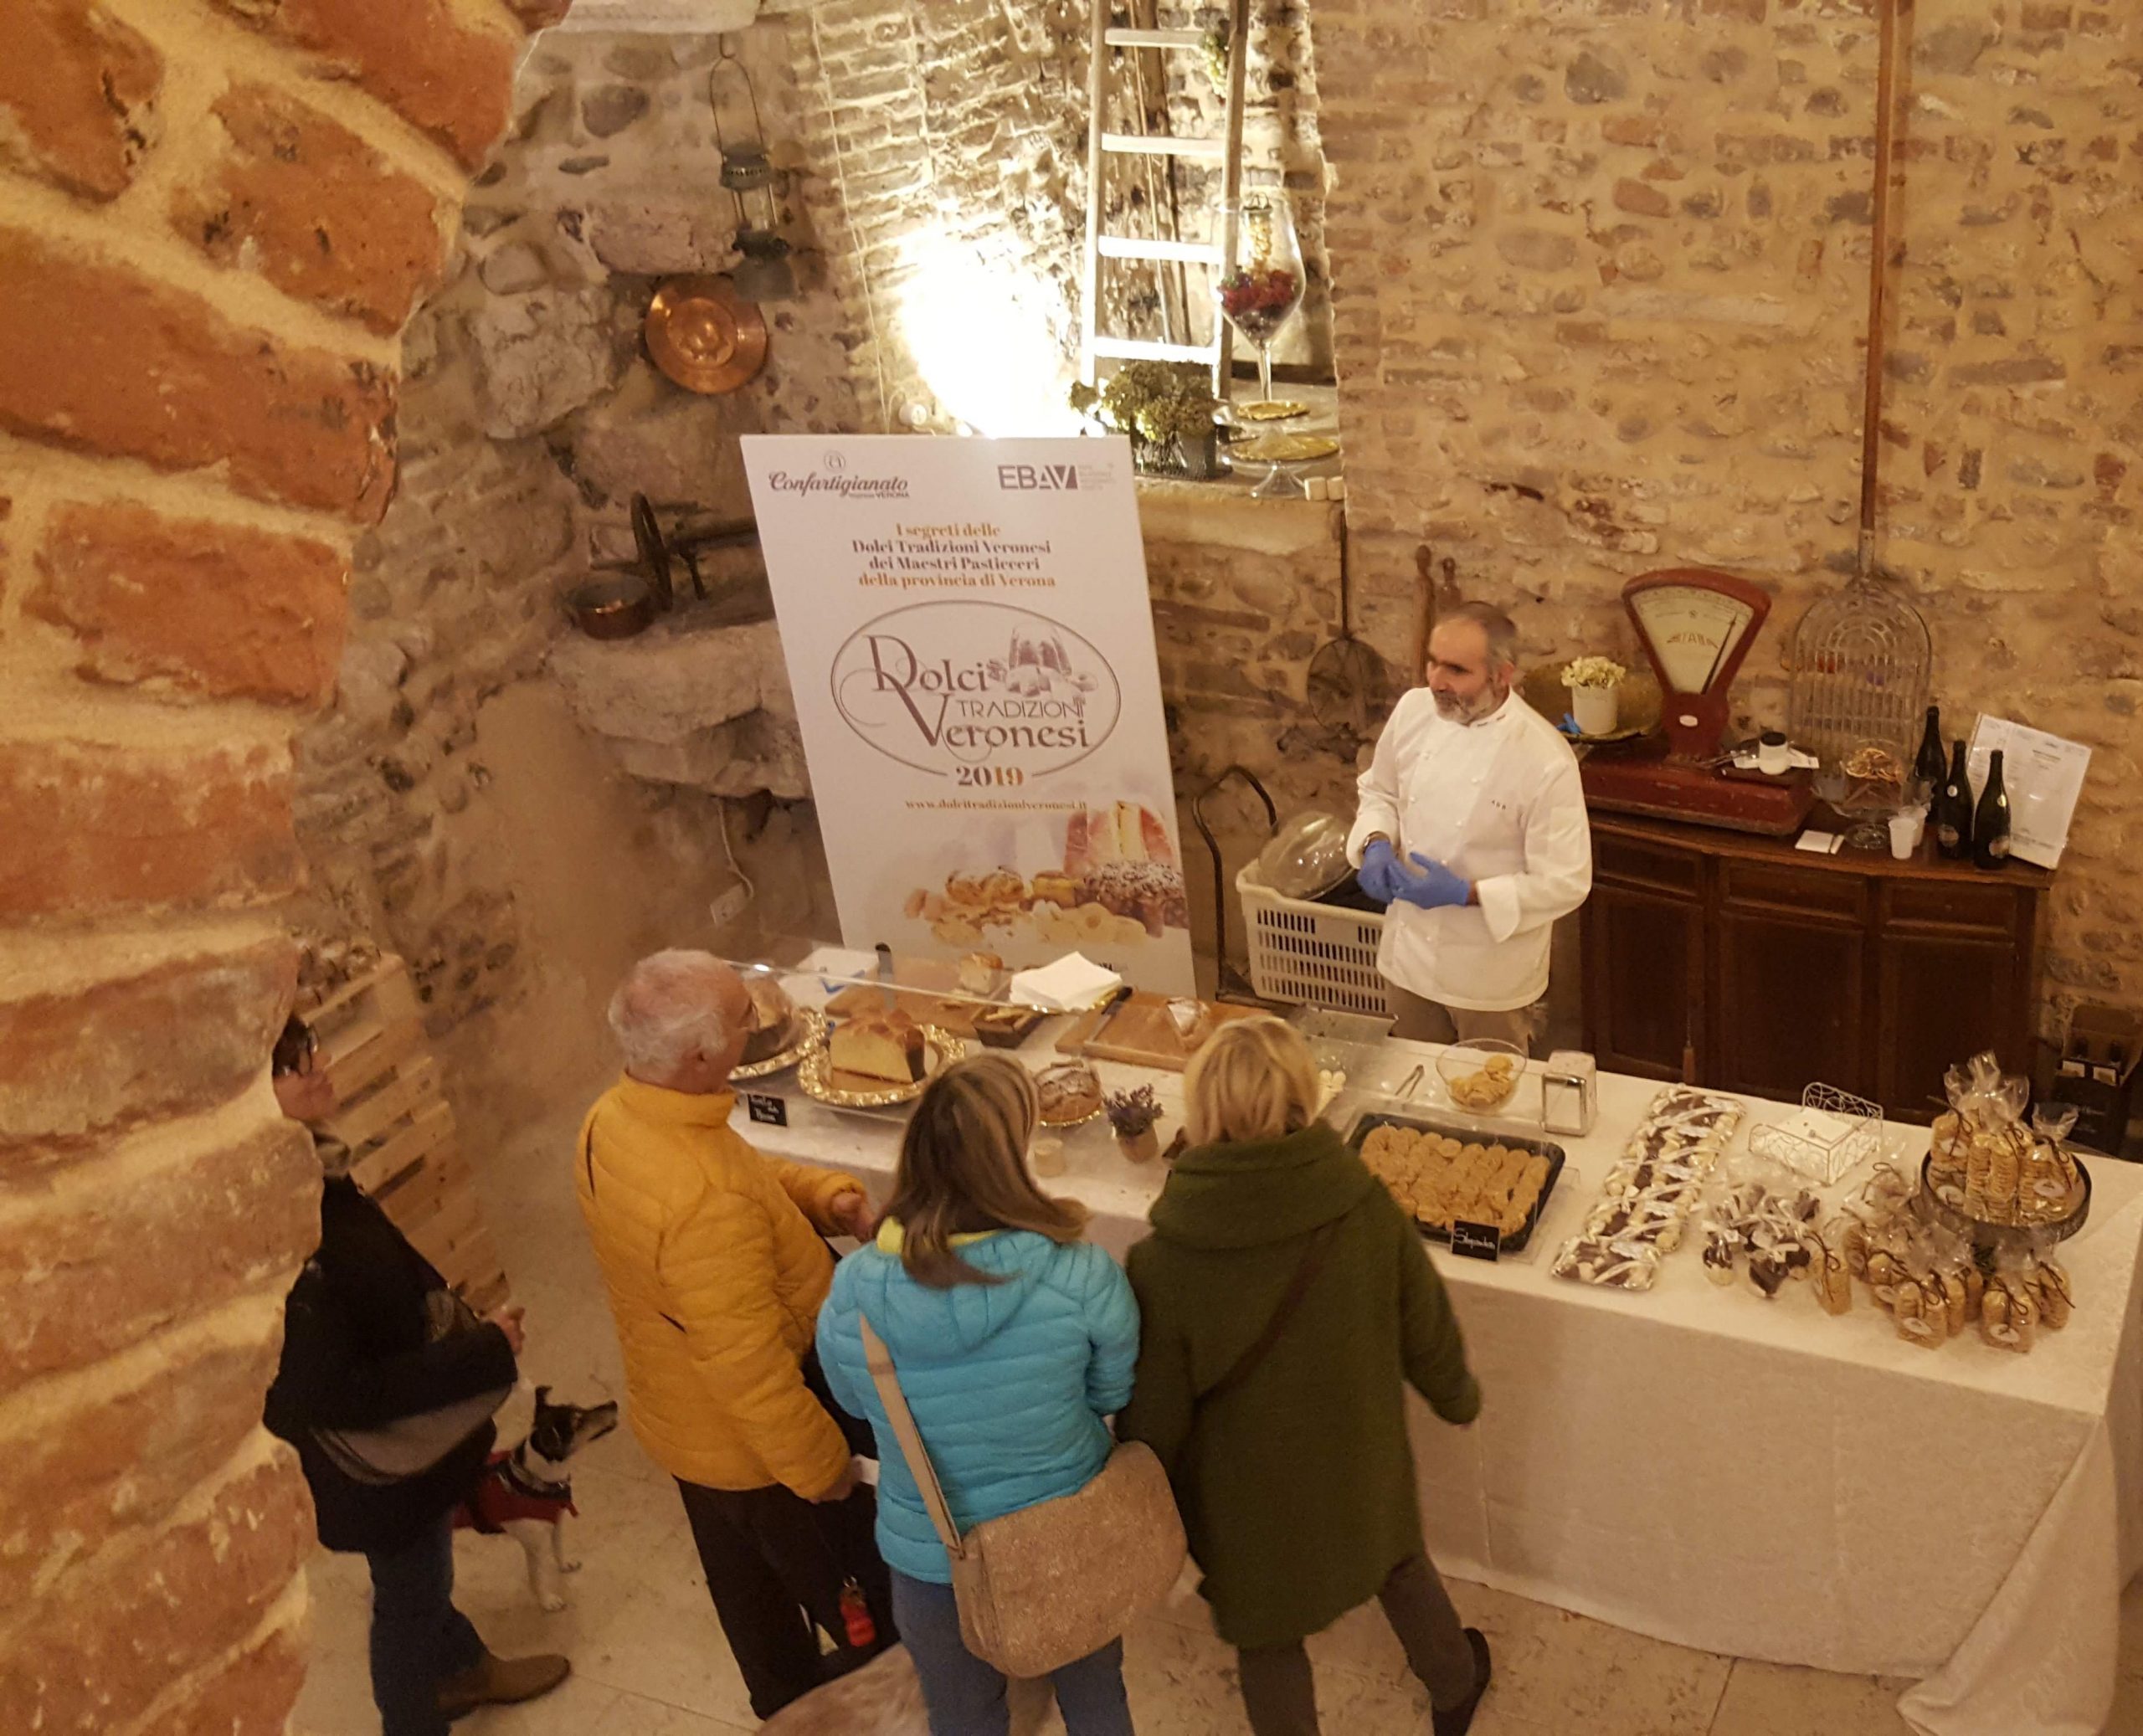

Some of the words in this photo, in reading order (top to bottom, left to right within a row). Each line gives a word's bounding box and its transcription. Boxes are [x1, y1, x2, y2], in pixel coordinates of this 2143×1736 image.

[768, 471, 908, 497] Confartigianato
[998, 465, 1078, 490] EBAV
[896, 523, 902, 537] I
[905, 523, 960, 540] segreti
[963, 523, 1000, 537] delle
[852, 539, 893, 553] Dolci
[897, 539, 979, 553] Tradizioni
[983, 540, 1051, 554] Veronesi
[869, 556, 893, 570] dei
[897, 556, 958, 570] Maestri
[961, 557, 1041, 571] Pasticceri
[859, 573, 897, 587] della
[902, 573, 977, 590] provincia
[980, 573, 995, 587] di
[1000, 573, 1056, 587] Verona
[864, 634, 990, 692] Dolci
[886, 678, 1090, 747] Veronesi
[956, 700, 1085, 719] TRADIZIONI
[955, 766, 1025, 787] 2019
